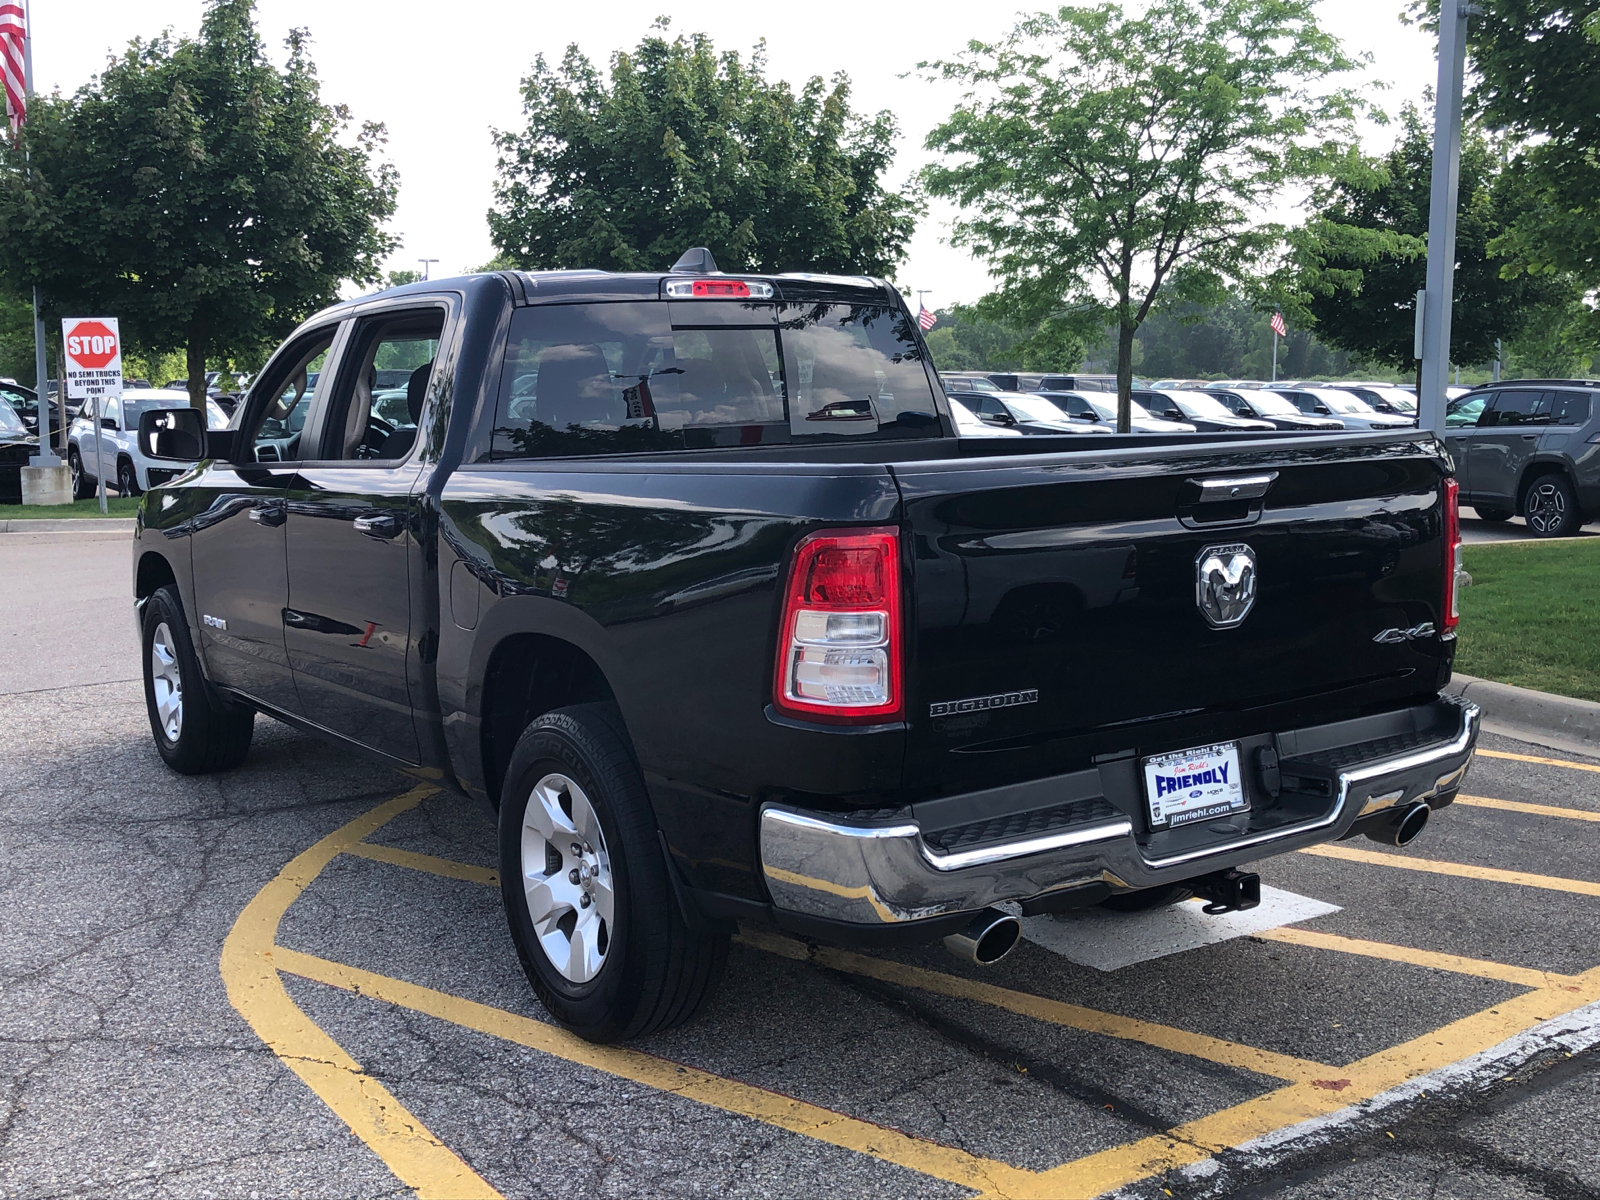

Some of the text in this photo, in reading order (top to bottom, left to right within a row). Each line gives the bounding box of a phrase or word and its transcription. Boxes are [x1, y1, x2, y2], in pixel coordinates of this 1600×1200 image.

[68, 336, 114, 355] STOP
[68, 370, 121, 379] NO SEMI TRUCKS
[74, 378, 116, 387] BEYOND THIS
[86, 387, 105, 395] POINT
[203, 614, 226, 630] RAM
[929, 689, 1039, 718] BIGHORN
[1149, 755, 1167, 763] Get
[1168, 752, 1184, 760] the
[1186, 746, 1210, 756] Riehl
[1212, 742, 1233, 751] Deal
[1173, 762, 1209, 776] Jim Riehl's
[1155, 760, 1229, 799] FRIENDLY
[1170, 804, 1230, 826] jimriehl.com
